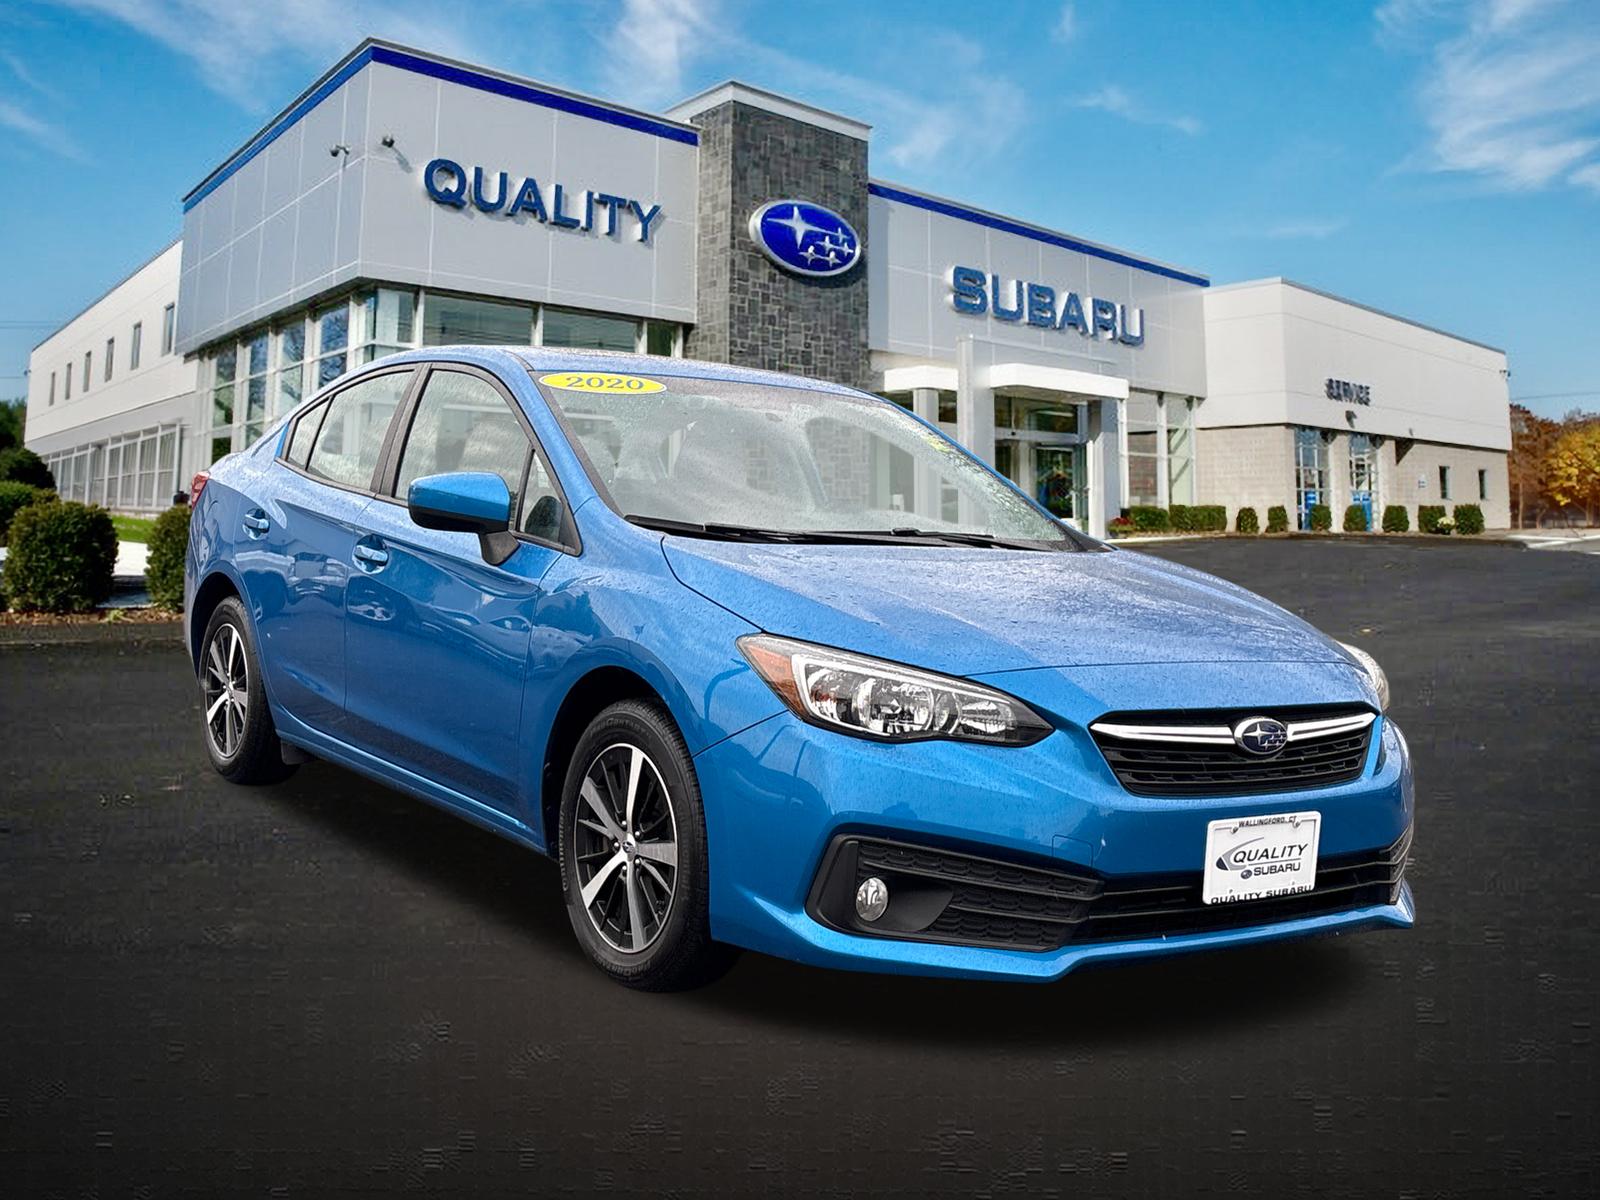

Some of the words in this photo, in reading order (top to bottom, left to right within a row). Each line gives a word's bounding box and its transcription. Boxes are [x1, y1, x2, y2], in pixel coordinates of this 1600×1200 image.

[424, 158, 662, 243] QUALITY
[950, 265, 1145, 347] SUBARU
[565, 376, 644, 390] 2020
[1325, 378, 1371, 407] SERVICE
[1233, 843, 1308, 863] QUALITY
[1253, 862, 1301, 876] SUBARU
[1211, 892, 1262, 905] QUALITY
[1266, 884, 1312, 898] SUBARU
